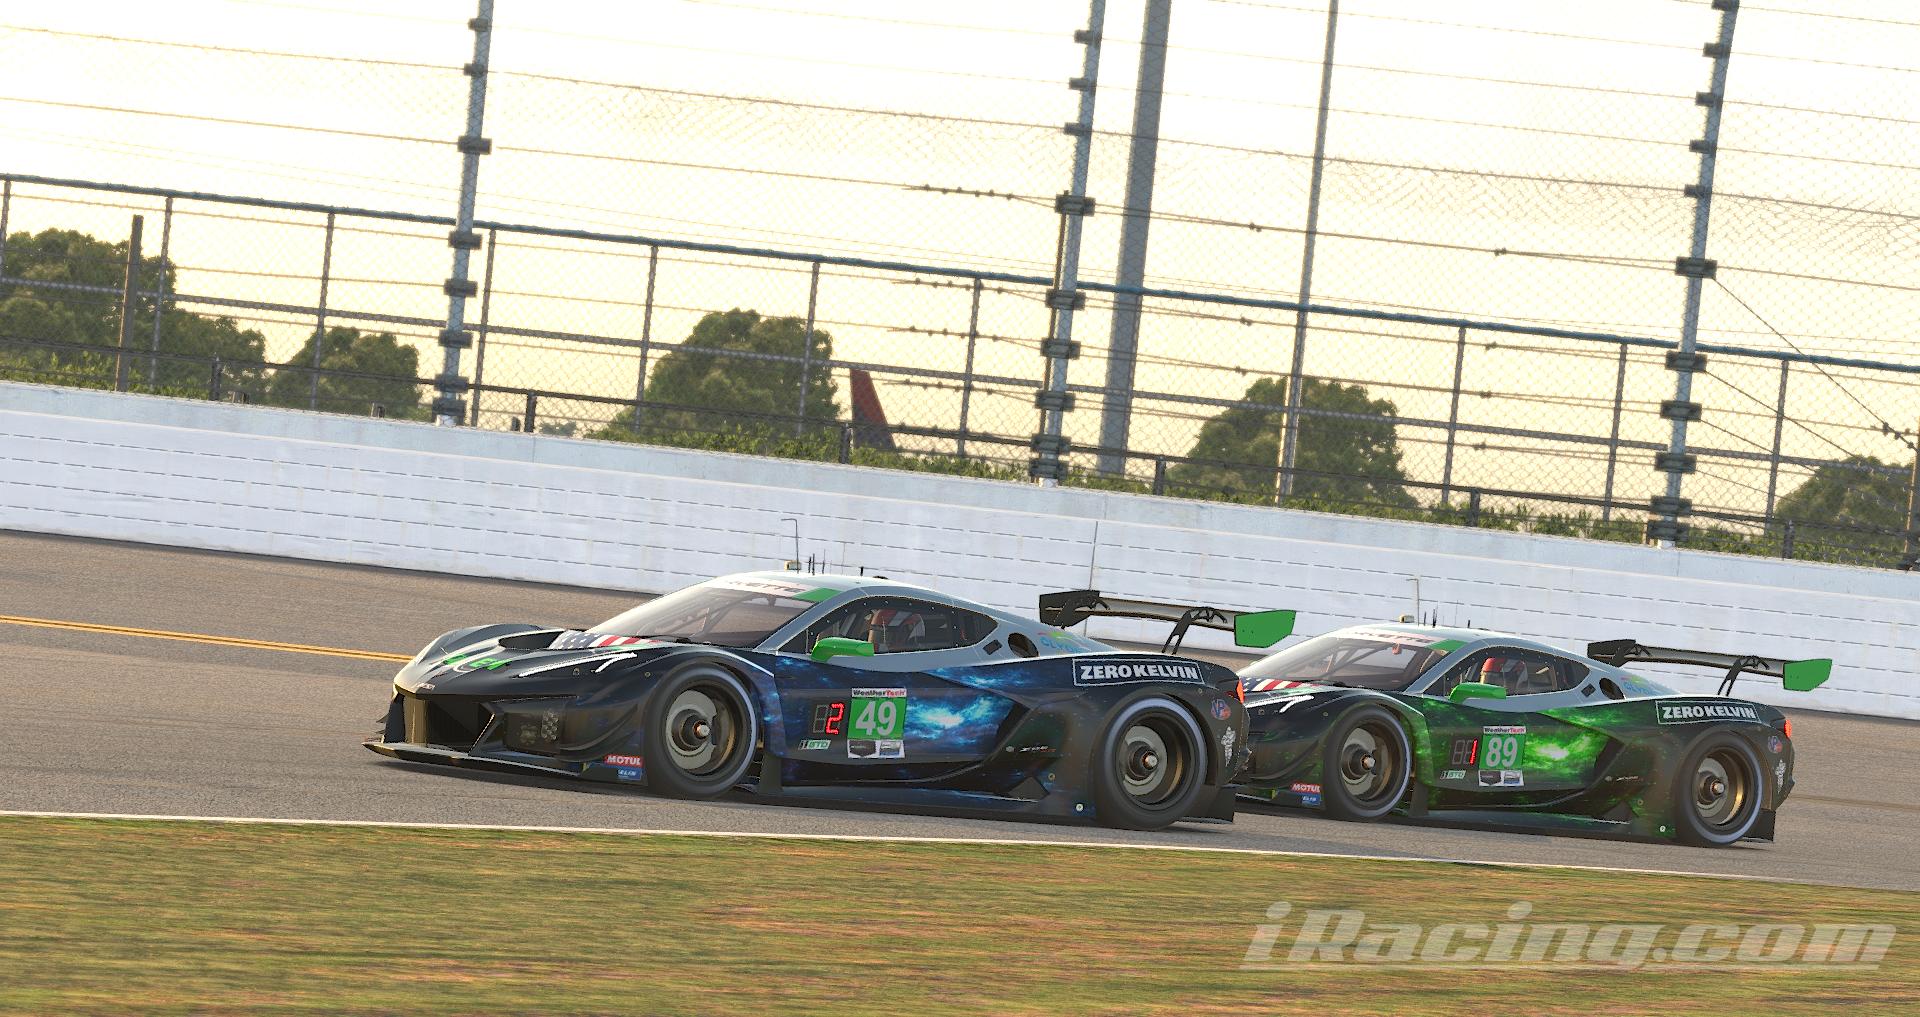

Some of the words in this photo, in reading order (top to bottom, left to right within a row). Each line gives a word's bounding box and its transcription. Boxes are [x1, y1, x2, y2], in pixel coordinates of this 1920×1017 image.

[856, 700, 897, 736] 49
[607, 755, 641, 765] MOTUL
[1485, 736, 1518, 768] 89
[1291, 783, 1321, 793] MOTUL
